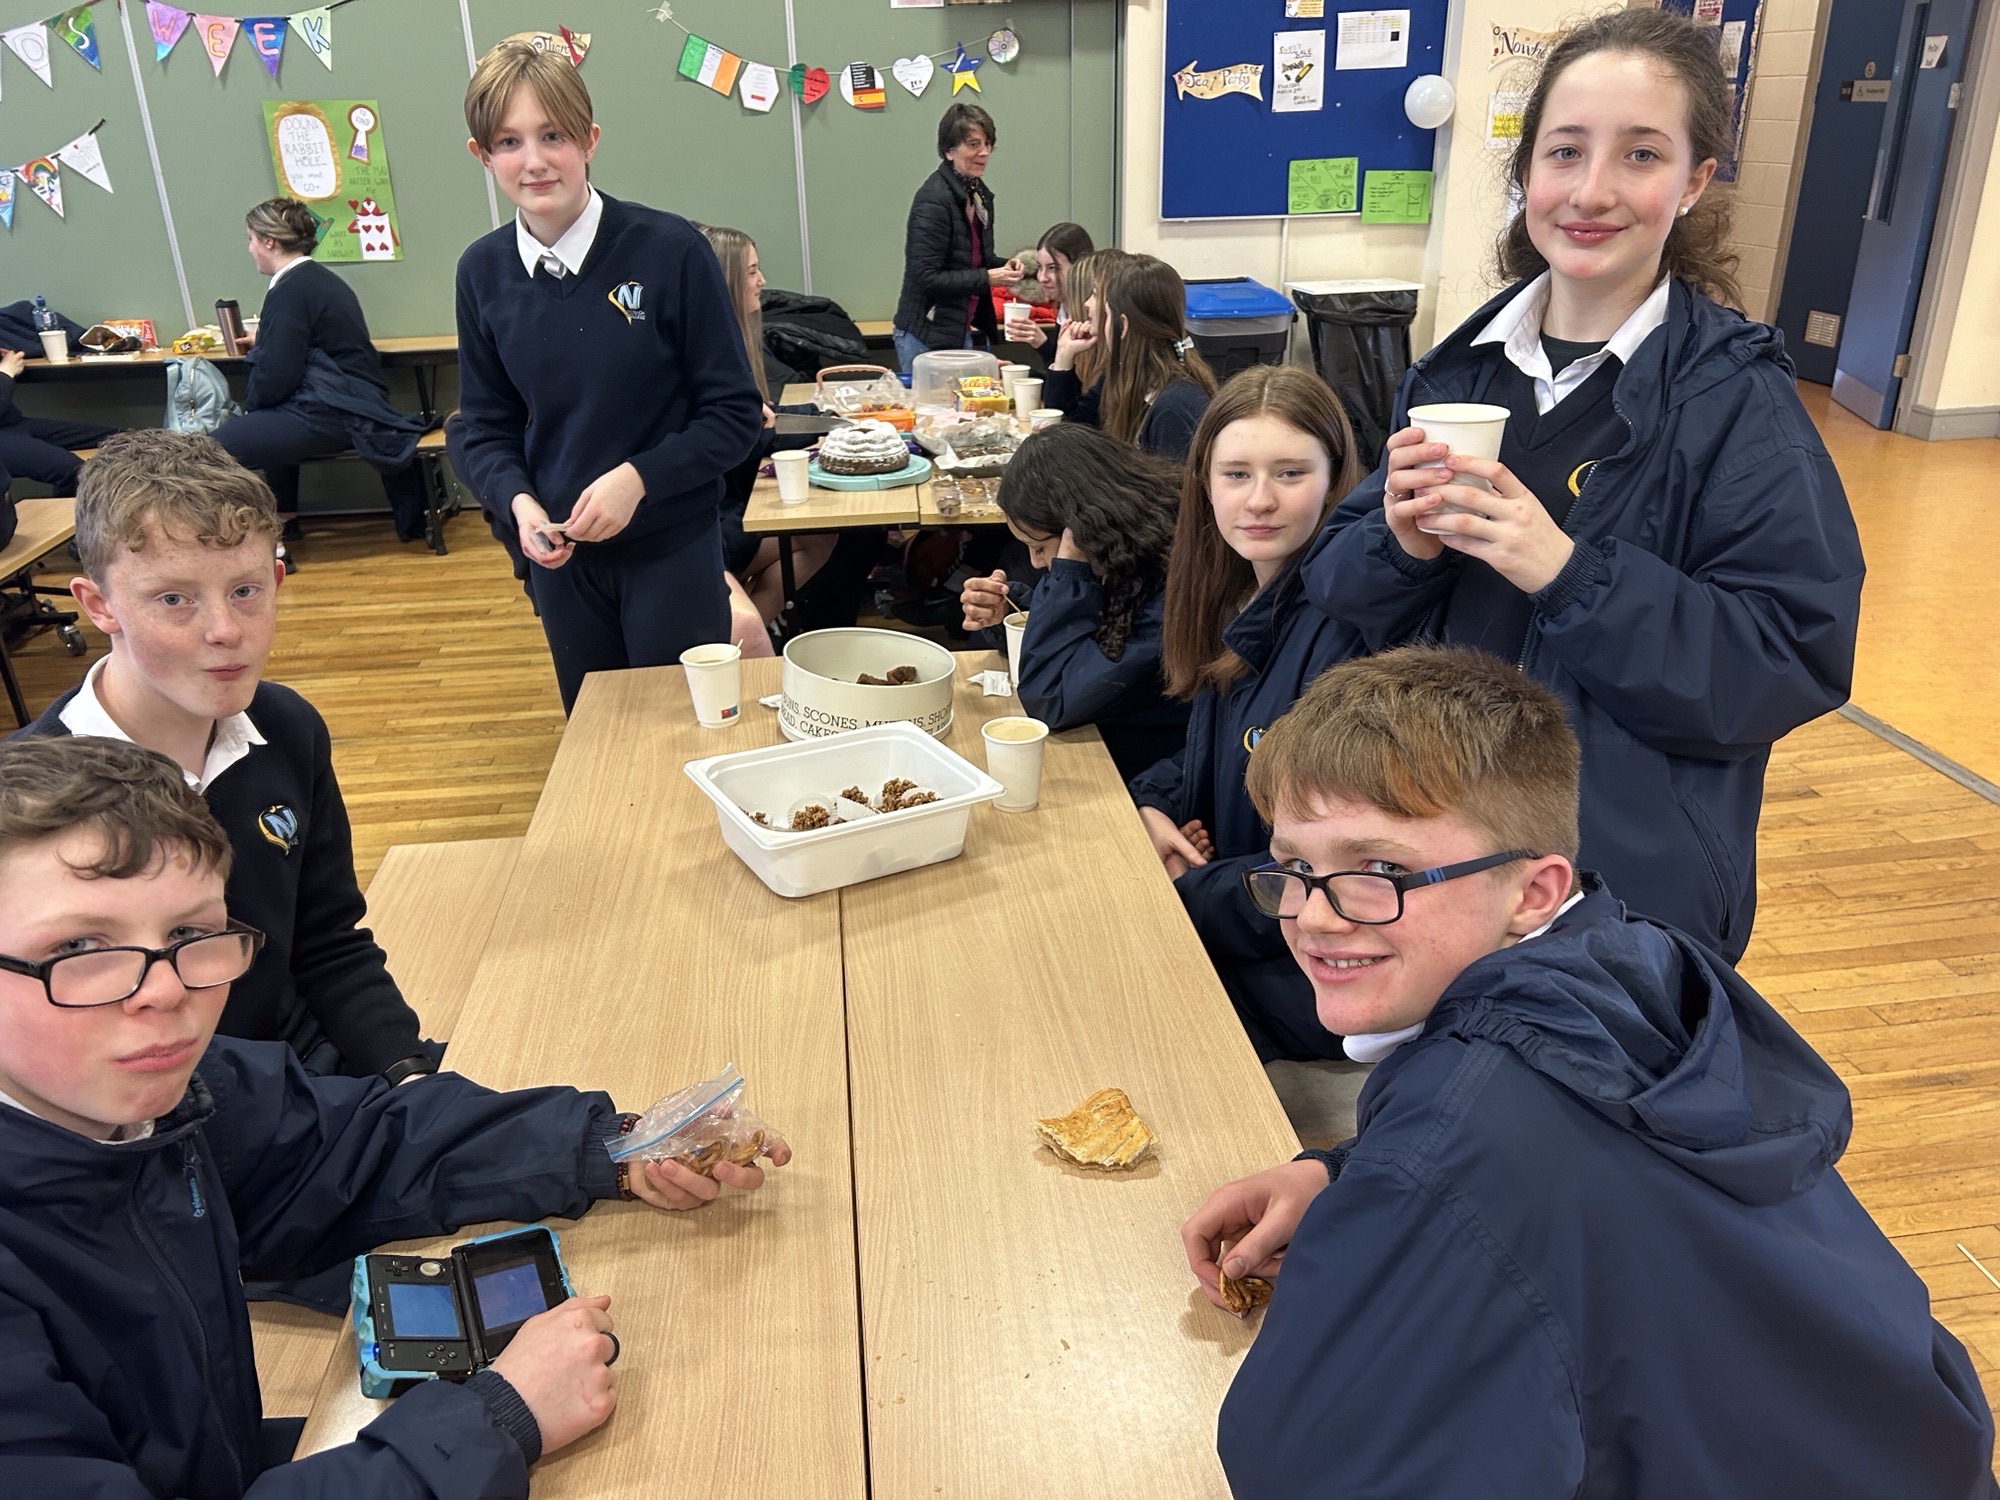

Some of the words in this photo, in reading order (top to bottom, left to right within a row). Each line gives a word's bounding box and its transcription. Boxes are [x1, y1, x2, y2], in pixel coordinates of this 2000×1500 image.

[153, 10, 330, 57] WEEK
[1185, 73, 1209, 88] Tea
[1222, 69, 1249, 90] Party
[288, 130, 311, 142] THE
[284, 142, 324, 156] RABBIT
